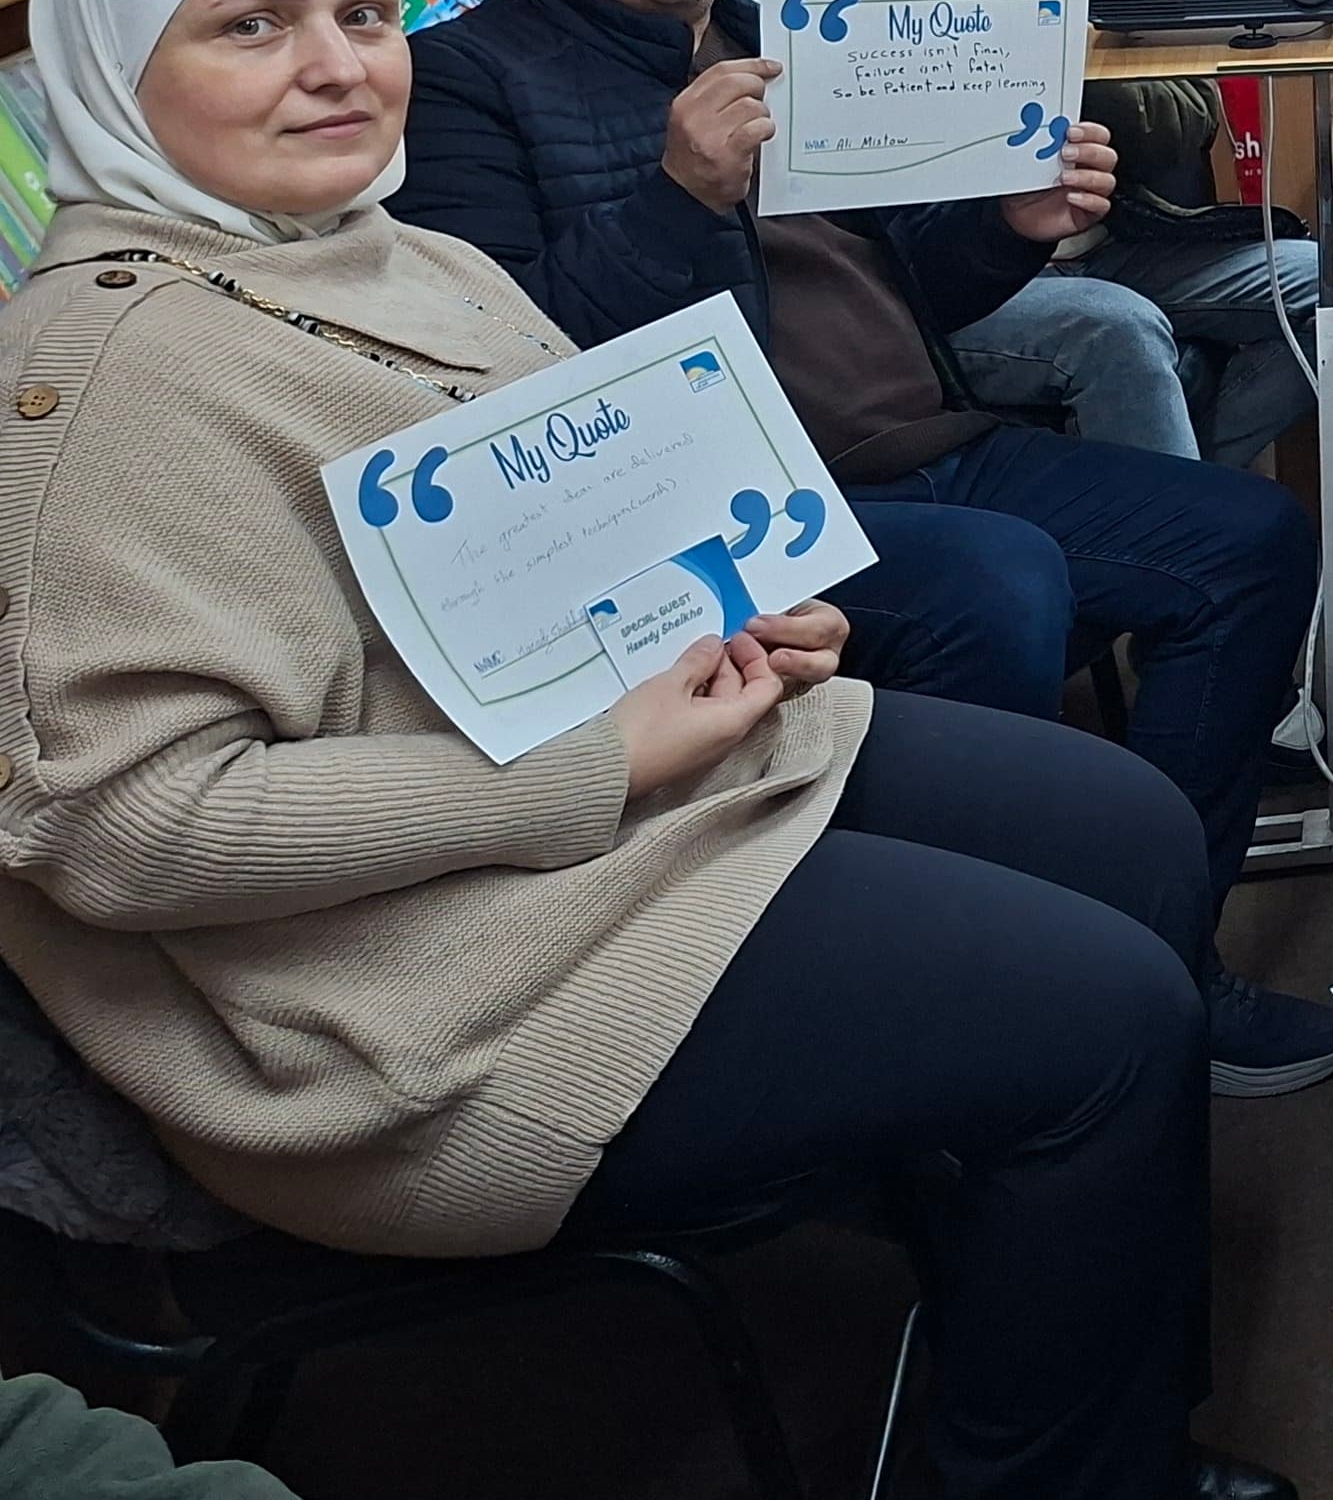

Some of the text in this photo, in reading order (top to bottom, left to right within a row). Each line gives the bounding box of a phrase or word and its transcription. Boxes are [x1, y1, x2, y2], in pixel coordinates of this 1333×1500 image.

[889, 1, 993, 46] My Quote
[923, 43, 959, 58] isn't
[919, 60, 954, 76] isn't
[860, 83, 877, 97] be
[936, 79, 956, 92] and
[836, 137, 852, 151] Ali
[490, 398, 631, 491] My Quote
[659, 591, 692, 618] GUEST
